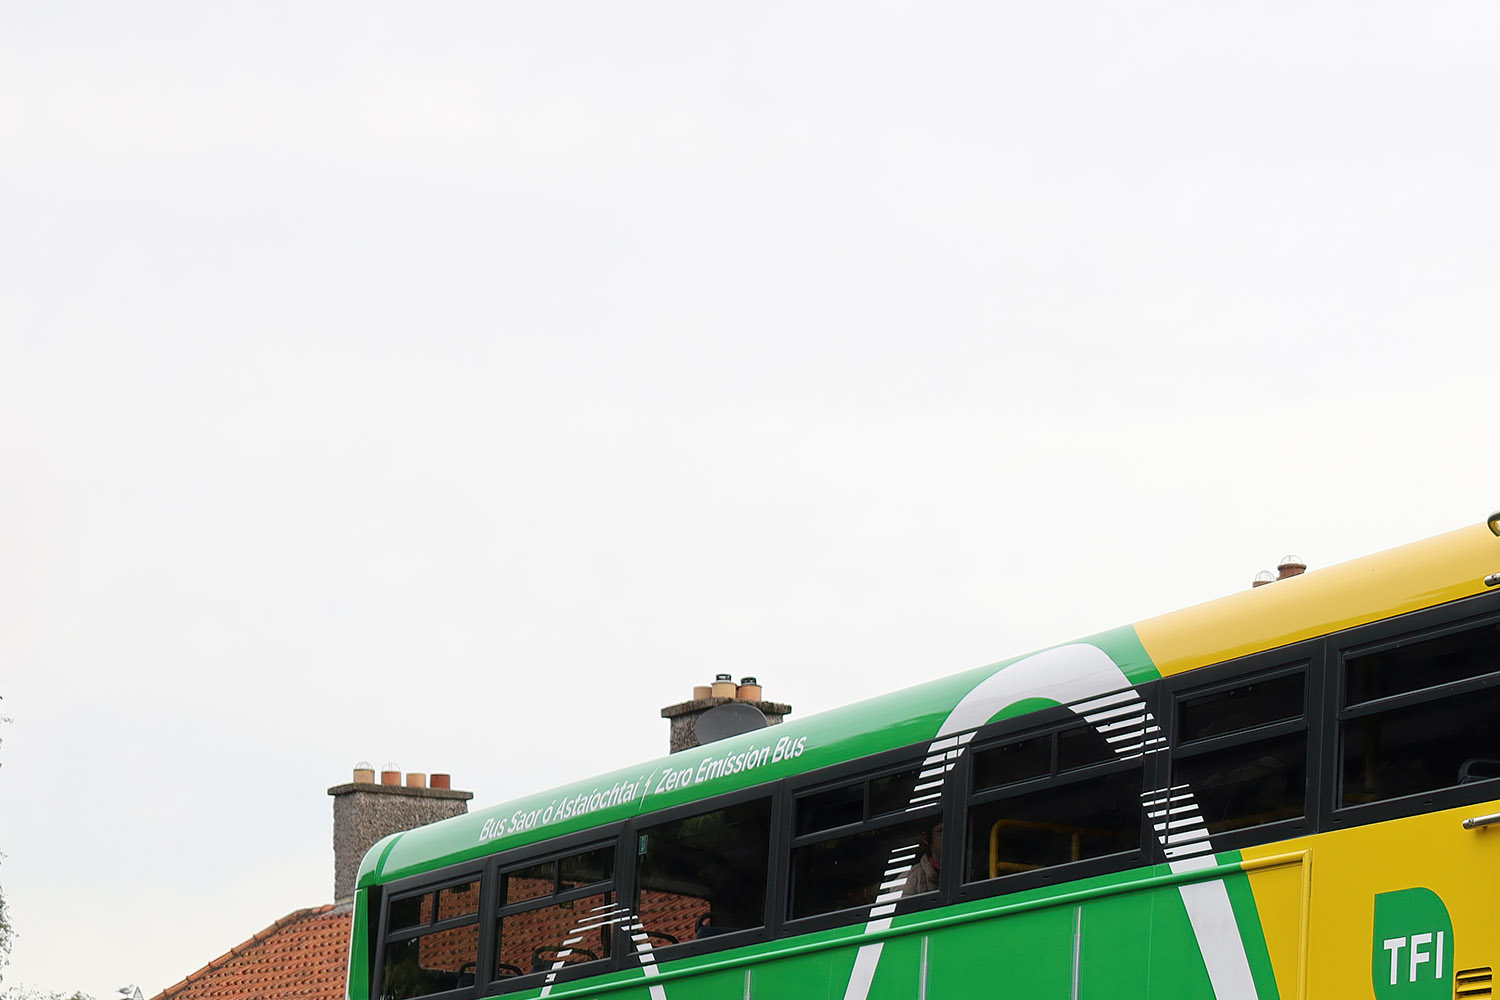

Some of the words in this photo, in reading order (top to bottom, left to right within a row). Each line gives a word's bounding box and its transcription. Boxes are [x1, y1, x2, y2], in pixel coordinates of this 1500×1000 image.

[478, 817, 508, 842] Bus
[507, 809, 543, 833] Saor
[542, 800, 556, 825] ó
[654, 767, 693, 794] Zero
[695, 745, 770, 784] Emission
[771, 735, 807, 764] Bus
[1383, 930, 1444, 985] TFI
